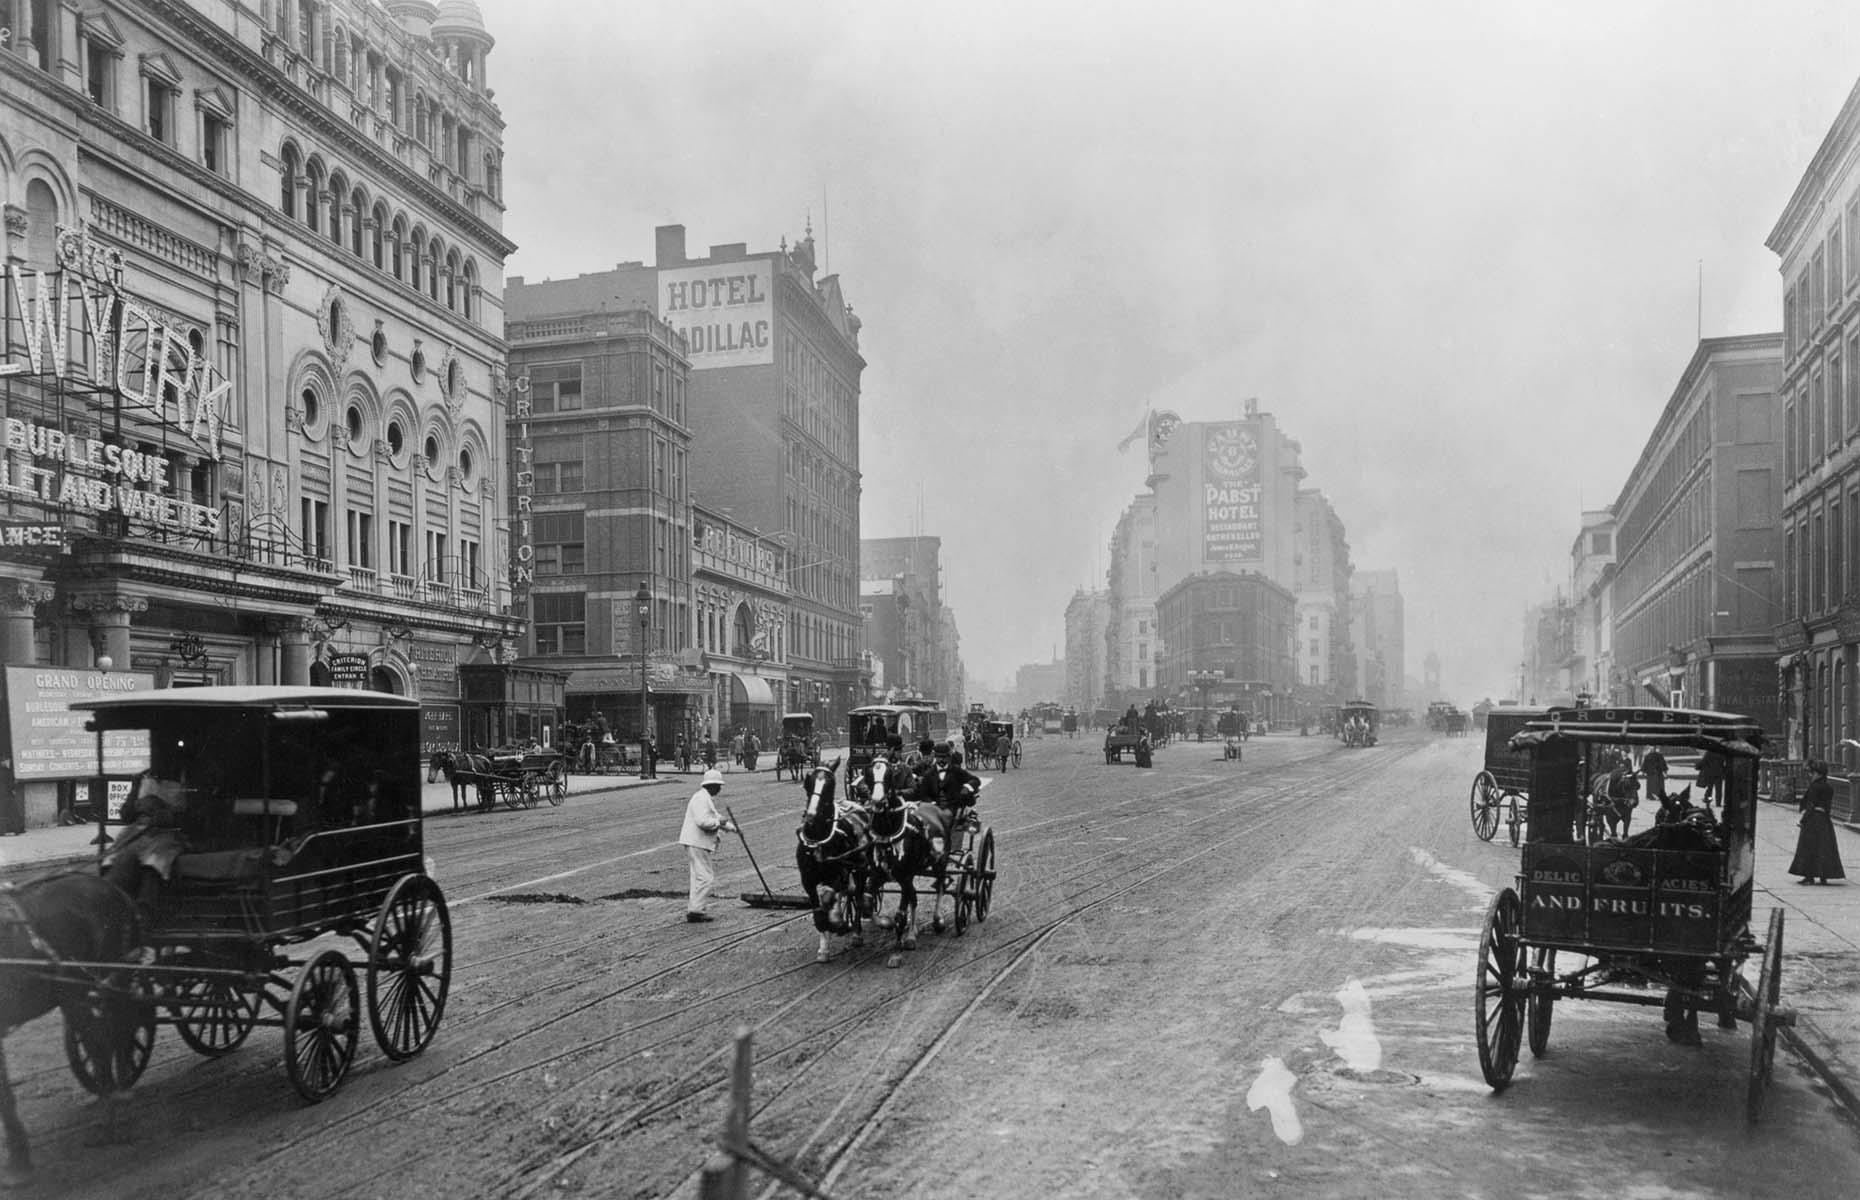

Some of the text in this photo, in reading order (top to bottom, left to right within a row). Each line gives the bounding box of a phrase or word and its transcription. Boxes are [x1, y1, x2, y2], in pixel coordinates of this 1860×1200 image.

[668, 273, 765, 311] HOTEL
[679, 320, 769, 353] ADILLAC
[0, 264, 233, 461] W YORK
[3, 417, 170, 487] BURLESQUE
[0, 460, 56, 500] LET
[59, 472, 113, 511] AND
[515, 376, 534, 583] CRITERION
[1206, 487, 1262, 504] PABST
[1208, 506, 1258, 520] HOTEL
[0, 526, 61, 546] NCE
[332, 656, 366, 666] CRITERION
[409, 645, 455, 664] RITERION
[36, 674, 135, 691] GRAND OPENING
[1551, 711, 1713, 724] GROCER.
[111, 783, 129, 792] BOX
[109, 793, 128, 801] OFFIC
[1533, 870, 1582, 883] DELIC
[1532, 895, 1581, 909] AND
